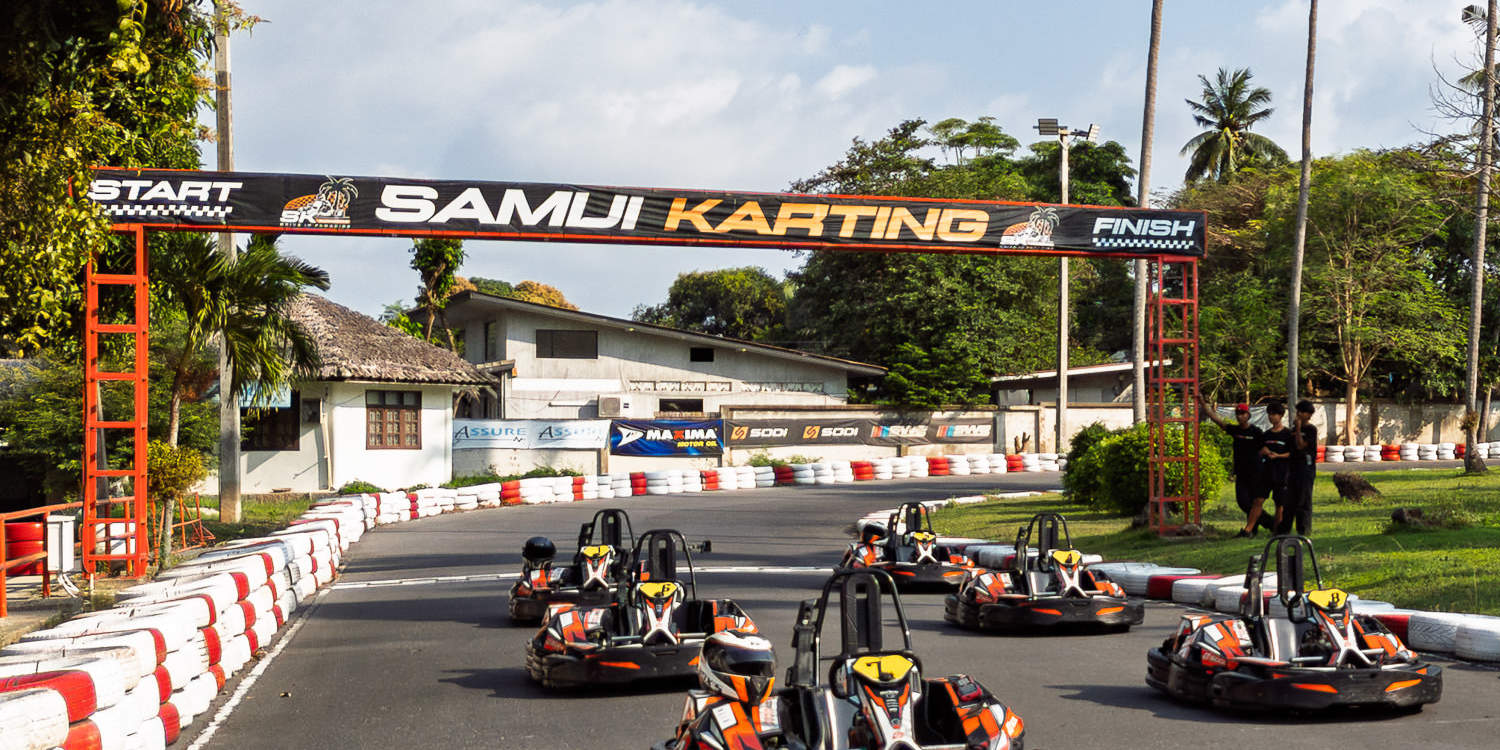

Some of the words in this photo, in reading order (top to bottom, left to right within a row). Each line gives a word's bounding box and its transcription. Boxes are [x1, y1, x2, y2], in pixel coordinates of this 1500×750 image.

[86, 179, 243, 202] START
[375, 184, 645, 231] SAMUI
[664, 196, 989, 242] KARTING
[1092, 217, 1196, 237] FINISH
[454, 425, 527, 438] ASSURE
[646, 428, 717, 440] MAXIMA
[750, 428, 788, 438] SODI
[821, 427, 859, 437] SODI
